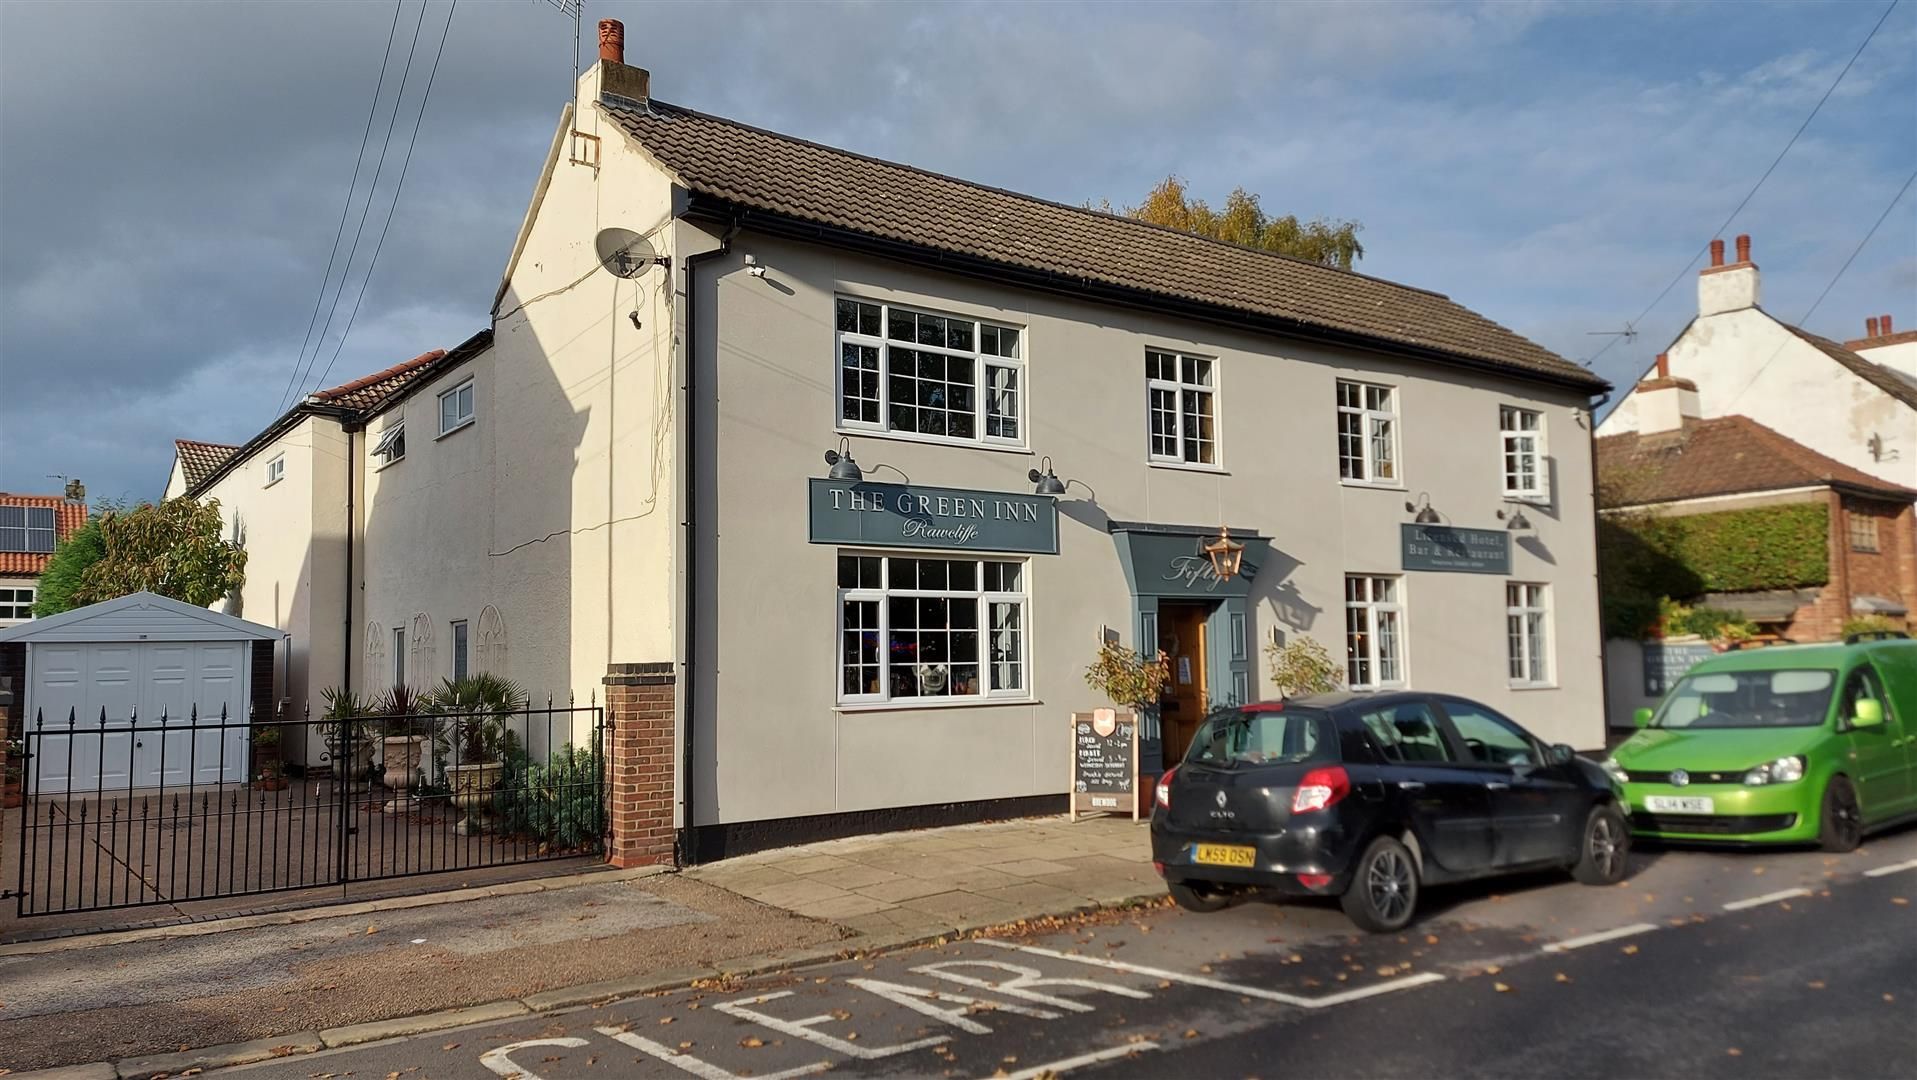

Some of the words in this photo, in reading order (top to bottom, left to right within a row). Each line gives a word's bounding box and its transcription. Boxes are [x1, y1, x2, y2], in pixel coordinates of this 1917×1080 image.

[829, 489, 885, 513] THE
[897, 493, 986, 519] GREEN
[994, 501, 1039, 522] INN
[902, 518, 979, 545] Rawcliffe
[1408, 543, 1429, 556] Bar
[1447, 547, 1505, 560] Retaurant
[1162, 555, 1222, 592] Fifty
[1210, 810, 1236, 818] CLIO
